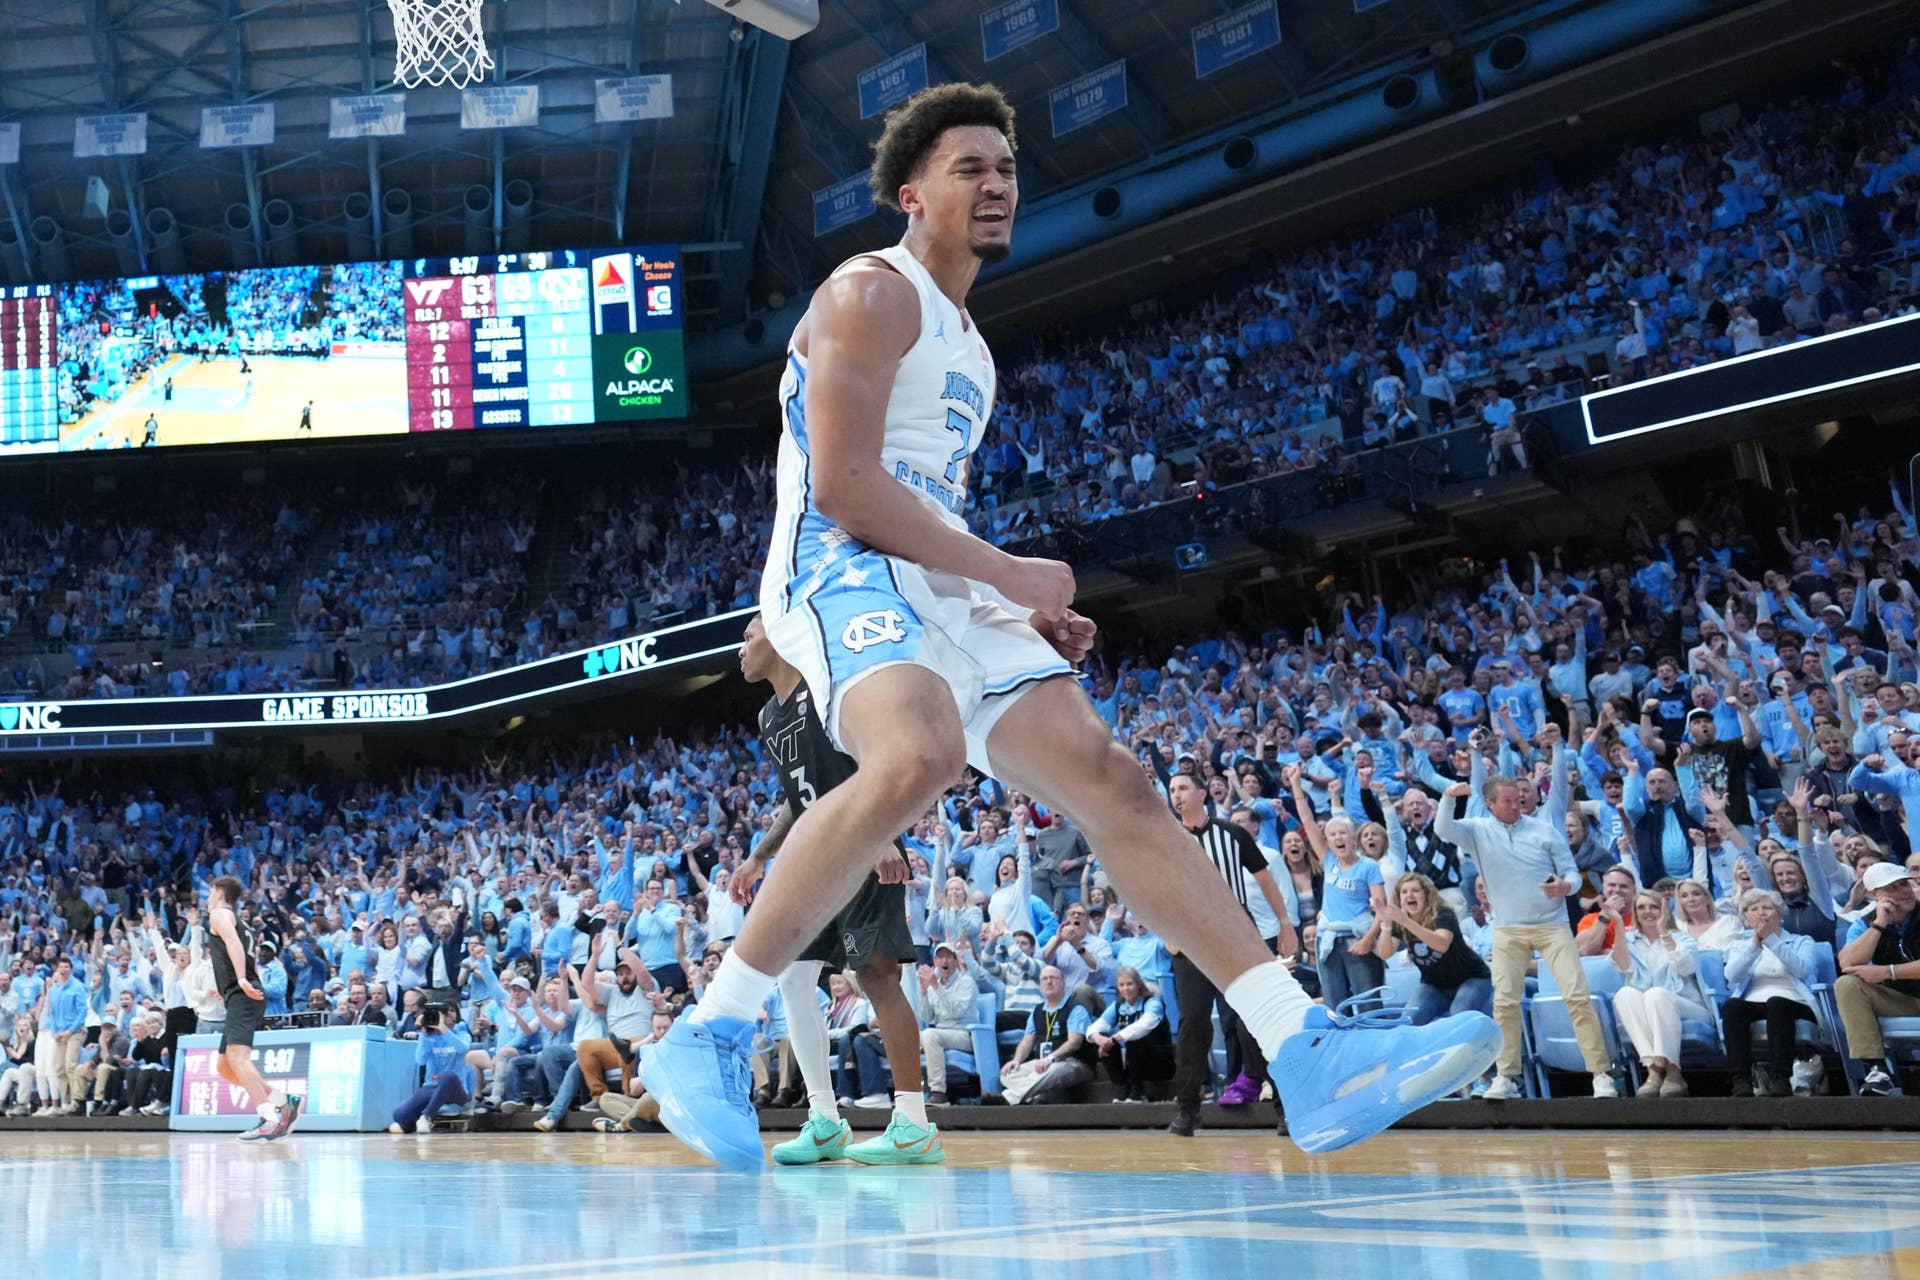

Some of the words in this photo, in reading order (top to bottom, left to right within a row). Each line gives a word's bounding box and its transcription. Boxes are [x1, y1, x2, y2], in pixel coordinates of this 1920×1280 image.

[405, 279, 454, 305] VT
[461, 275, 491, 305] 63
[427, 321, 450, 341] 12
[433, 343, 446, 363] 2
[430, 366, 449, 385] 11
[431, 388, 450, 407] 11
[606, 378, 674, 396] ALPACA
[940, 371, 985, 423] NORTH
[619, 396, 662, 407] CHICKEN
[431, 409, 454, 430] 13
[943, 407, 972, 484] 7
[262, 698, 325, 721] GAME
[332, 693, 428, 719] SPONSOR
[766, 716, 806, 766] VT
[789, 766, 817, 809] 3
